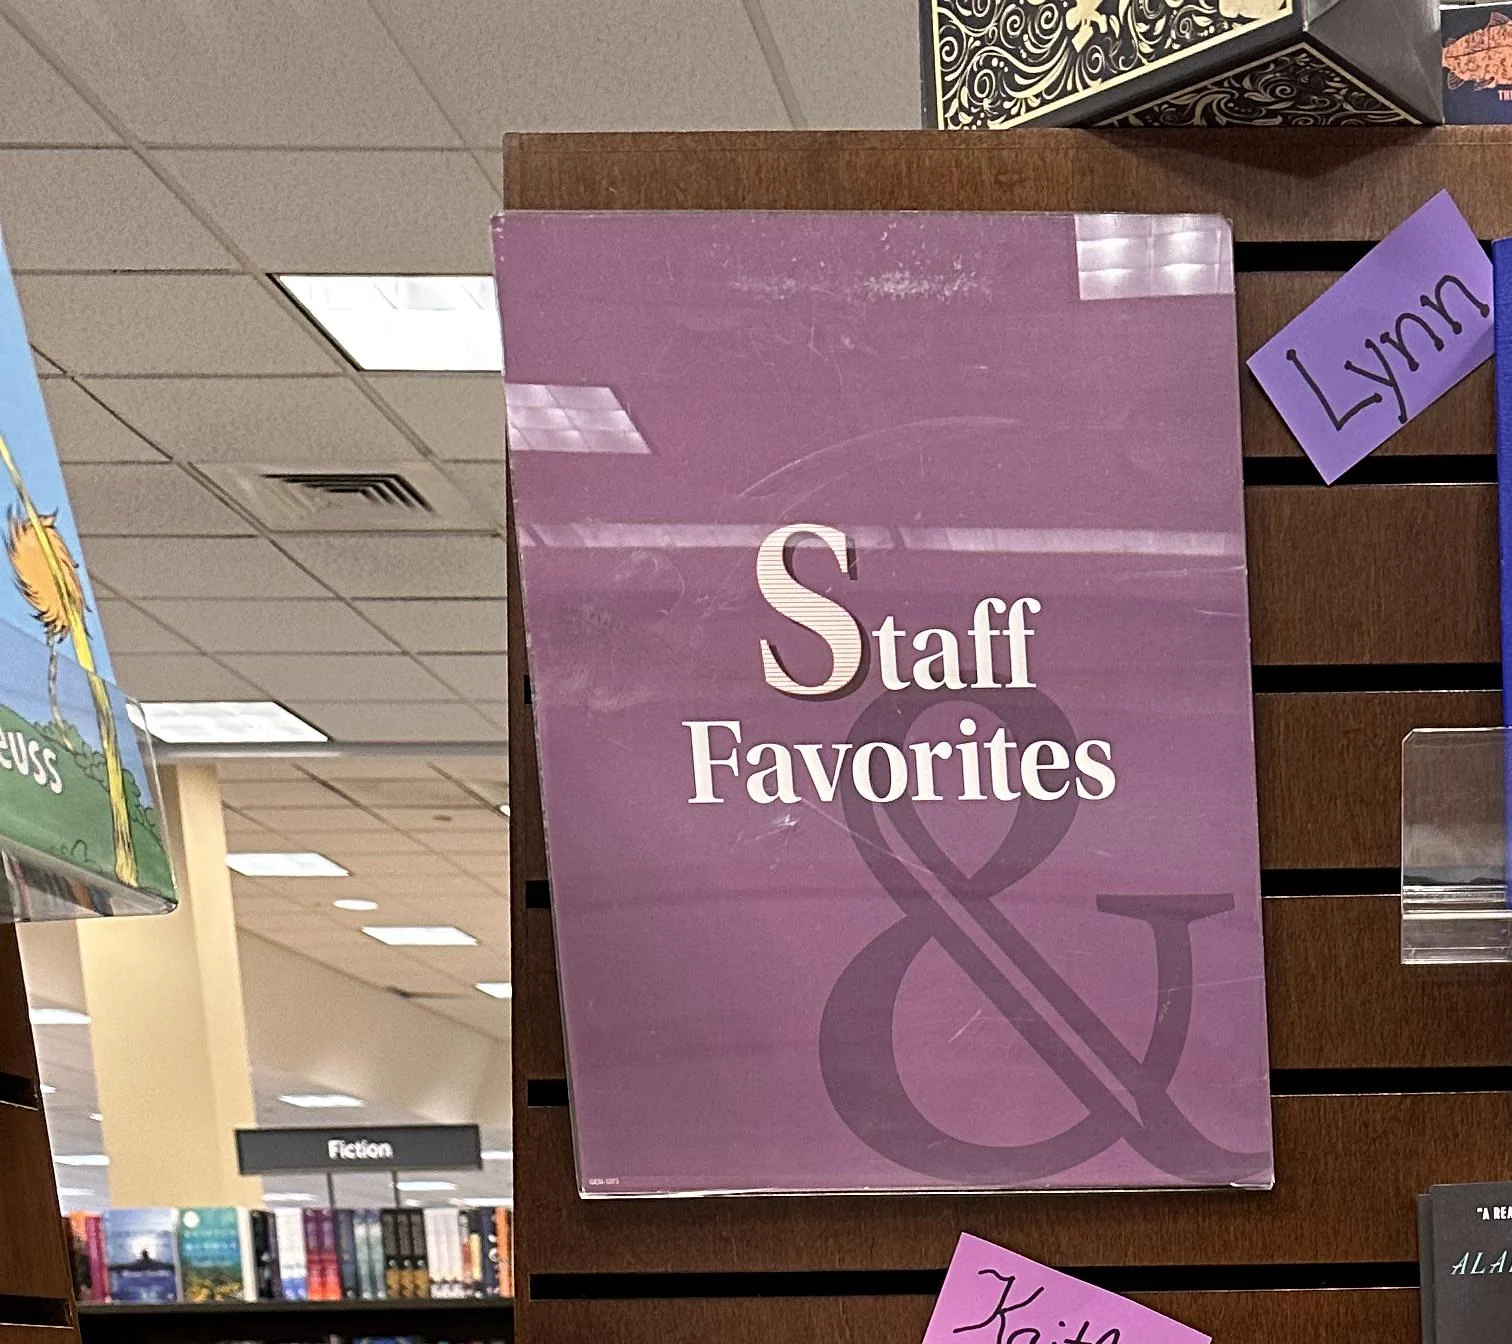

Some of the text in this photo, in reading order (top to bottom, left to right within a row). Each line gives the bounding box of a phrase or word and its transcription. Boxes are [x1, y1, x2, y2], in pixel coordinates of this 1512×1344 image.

[1286, 271, 1491, 433] Lynn
[756, 523, 1041, 697] Staff
[682, 717, 1117, 805] Favorites
[327, 1139, 393, 1160] Fiction
